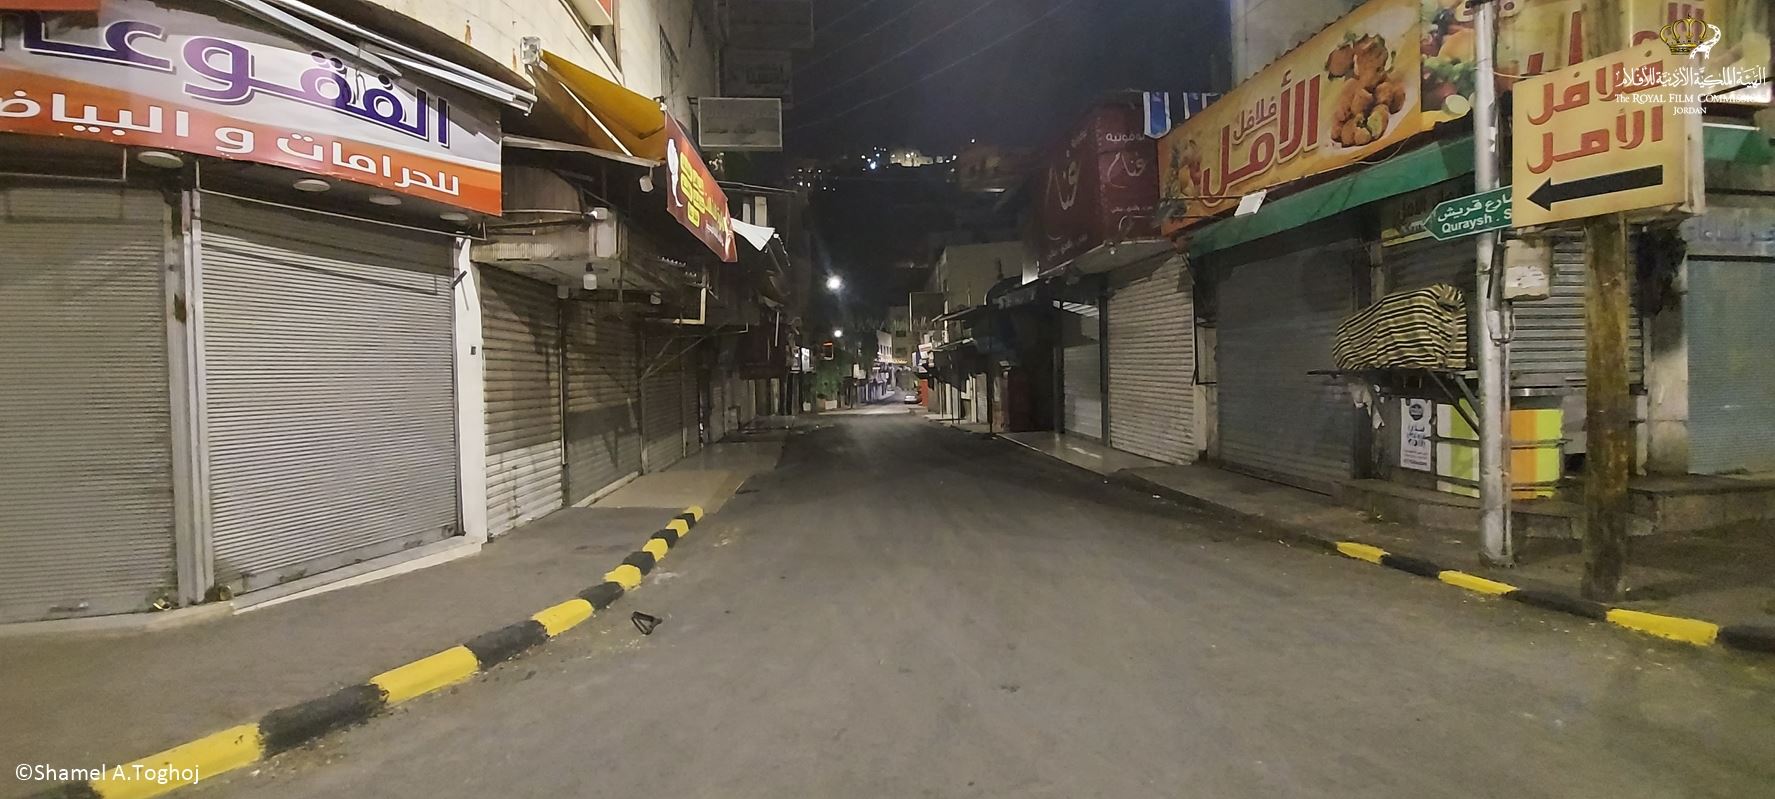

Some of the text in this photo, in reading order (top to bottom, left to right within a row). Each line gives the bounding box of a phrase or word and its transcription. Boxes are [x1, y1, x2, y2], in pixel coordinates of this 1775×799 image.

[1527, 50, 1664, 125] فلافل
[214, 126, 255, 154] و
[1201, 70, 1321, 206] الأمل
[1232, 97, 1278, 144] فلافل
[1527, 106, 1664, 174] الأمل
[276, 133, 460, 196] للحرامات
[1437, 193, 1512, 222] ارع قريش
[1442, 214, 1492, 233] Quraysh
